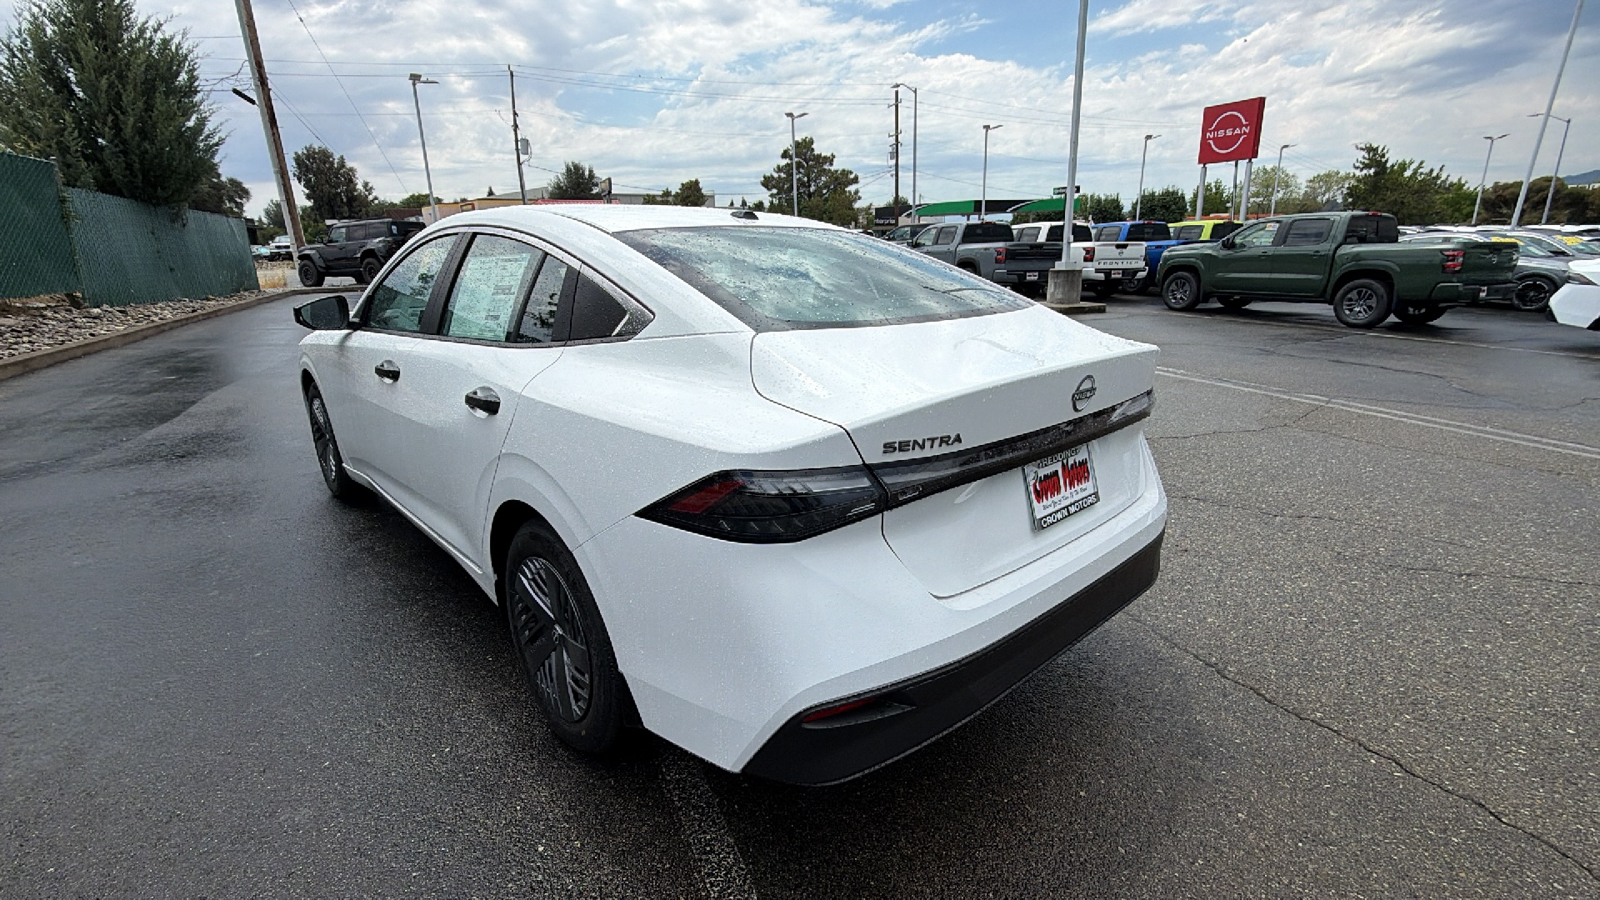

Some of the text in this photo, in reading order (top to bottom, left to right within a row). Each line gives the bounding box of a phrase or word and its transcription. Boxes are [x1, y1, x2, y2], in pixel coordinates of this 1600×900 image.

[1206, 126, 1250, 139] NISSAN
[882, 432, 963, 454] SENTRA
[1042, 447, 1078, 467] REDDING
[1032, 470, 1062, 505] Crown
[1061, 457, 1091, 492] Motors
[1041, 507, 1068, 528] CROWN
[1068, 494, 1097, 514] MOTORS
